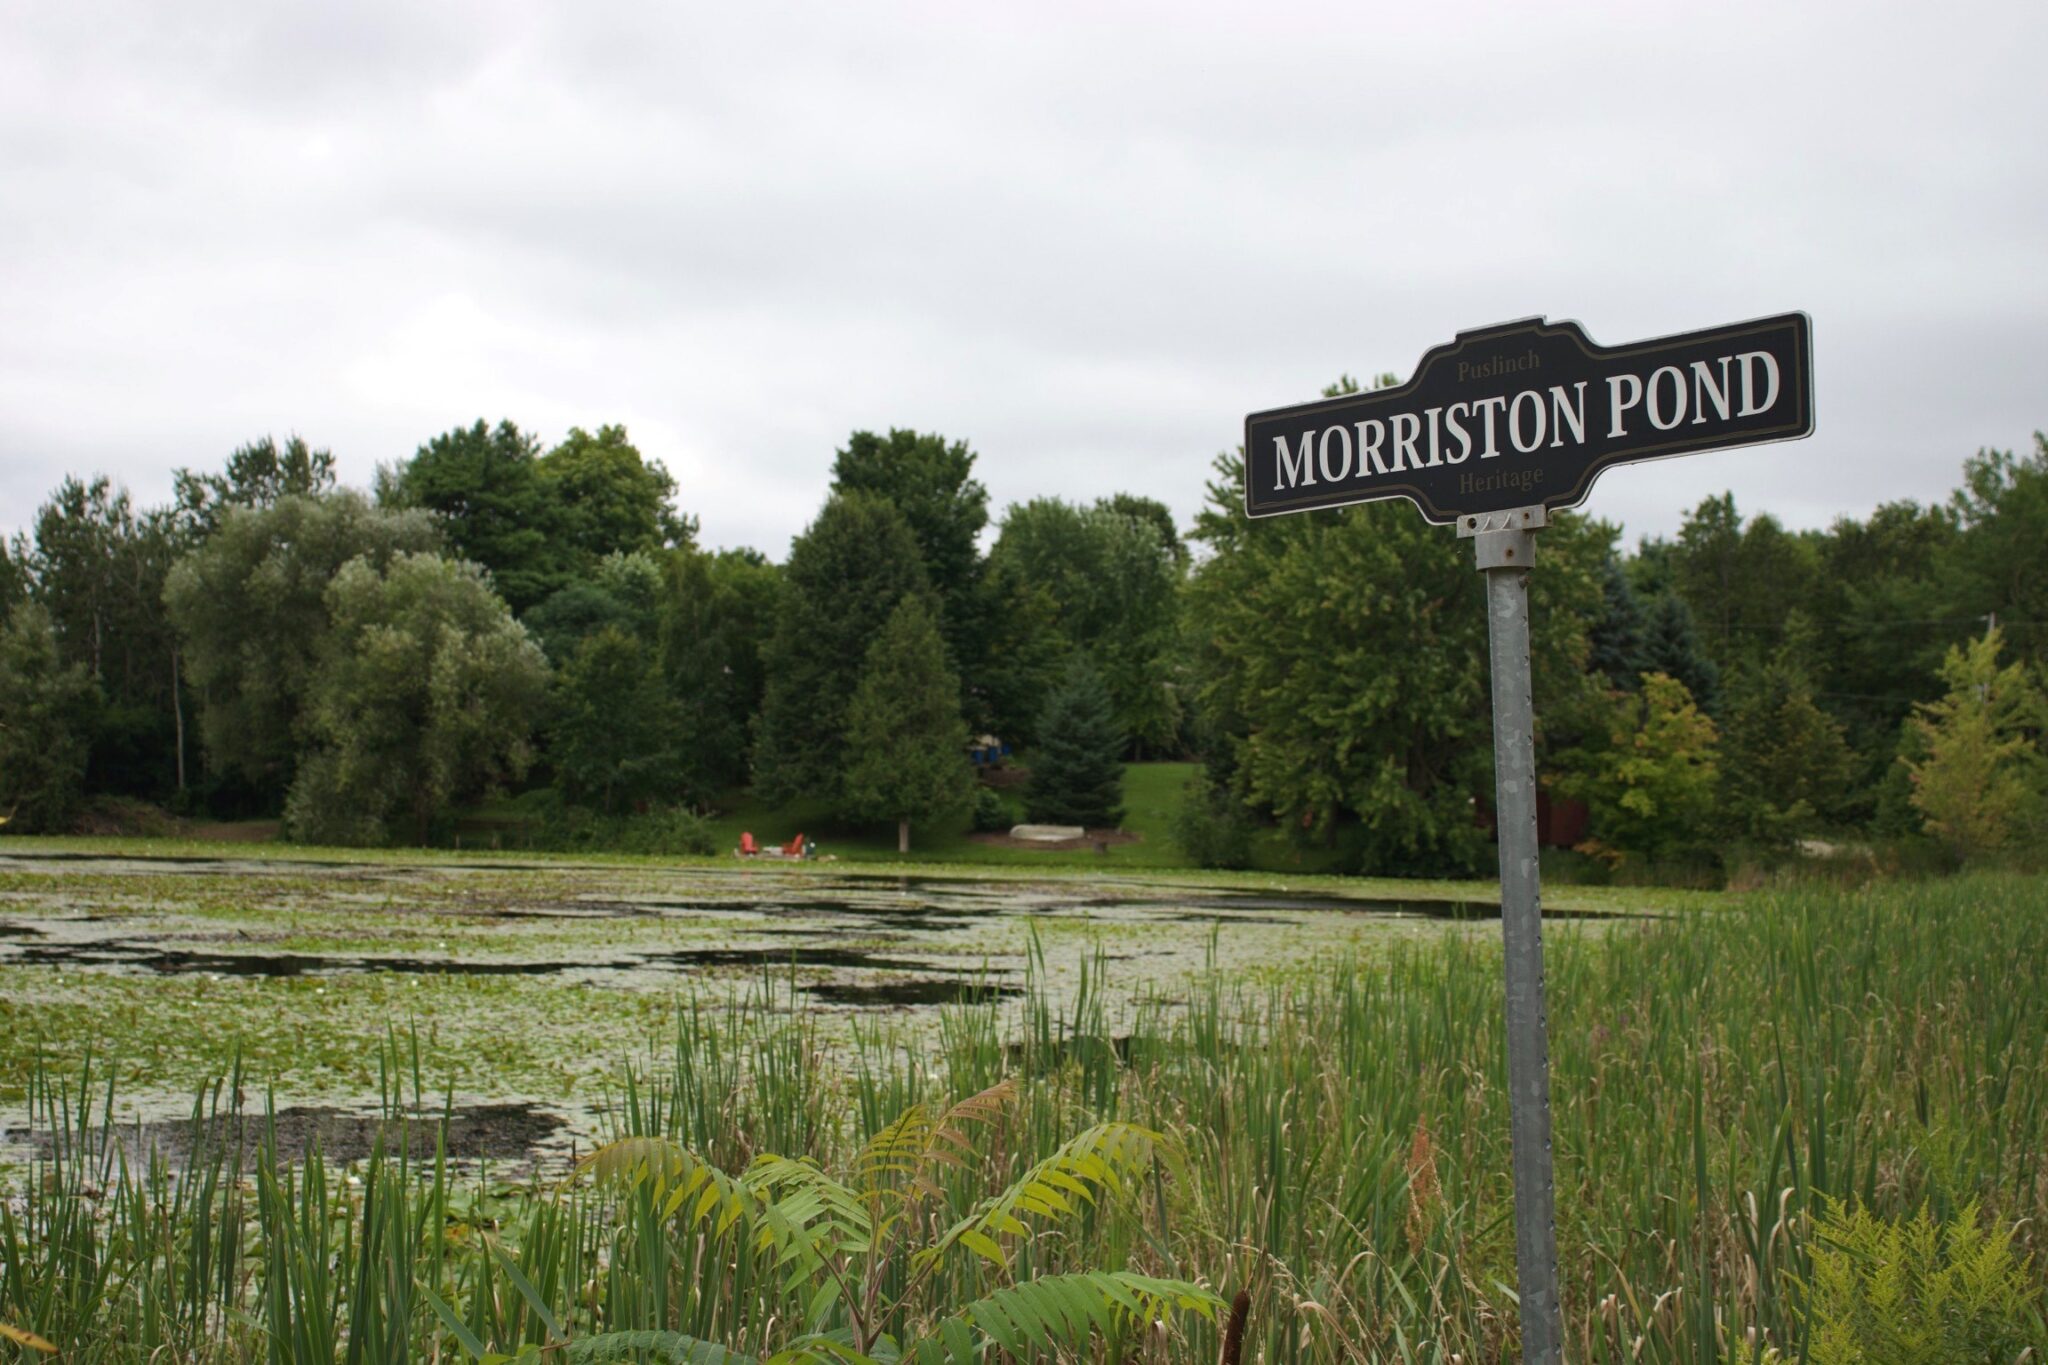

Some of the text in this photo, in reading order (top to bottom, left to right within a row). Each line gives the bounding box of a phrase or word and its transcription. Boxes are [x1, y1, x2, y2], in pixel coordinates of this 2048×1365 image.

[1457, 349, 1541, 382] Puslinch
[1272, 350, 1780, 491] MORRISTON POND
[1458, 466, 1544, 494] Heritage
